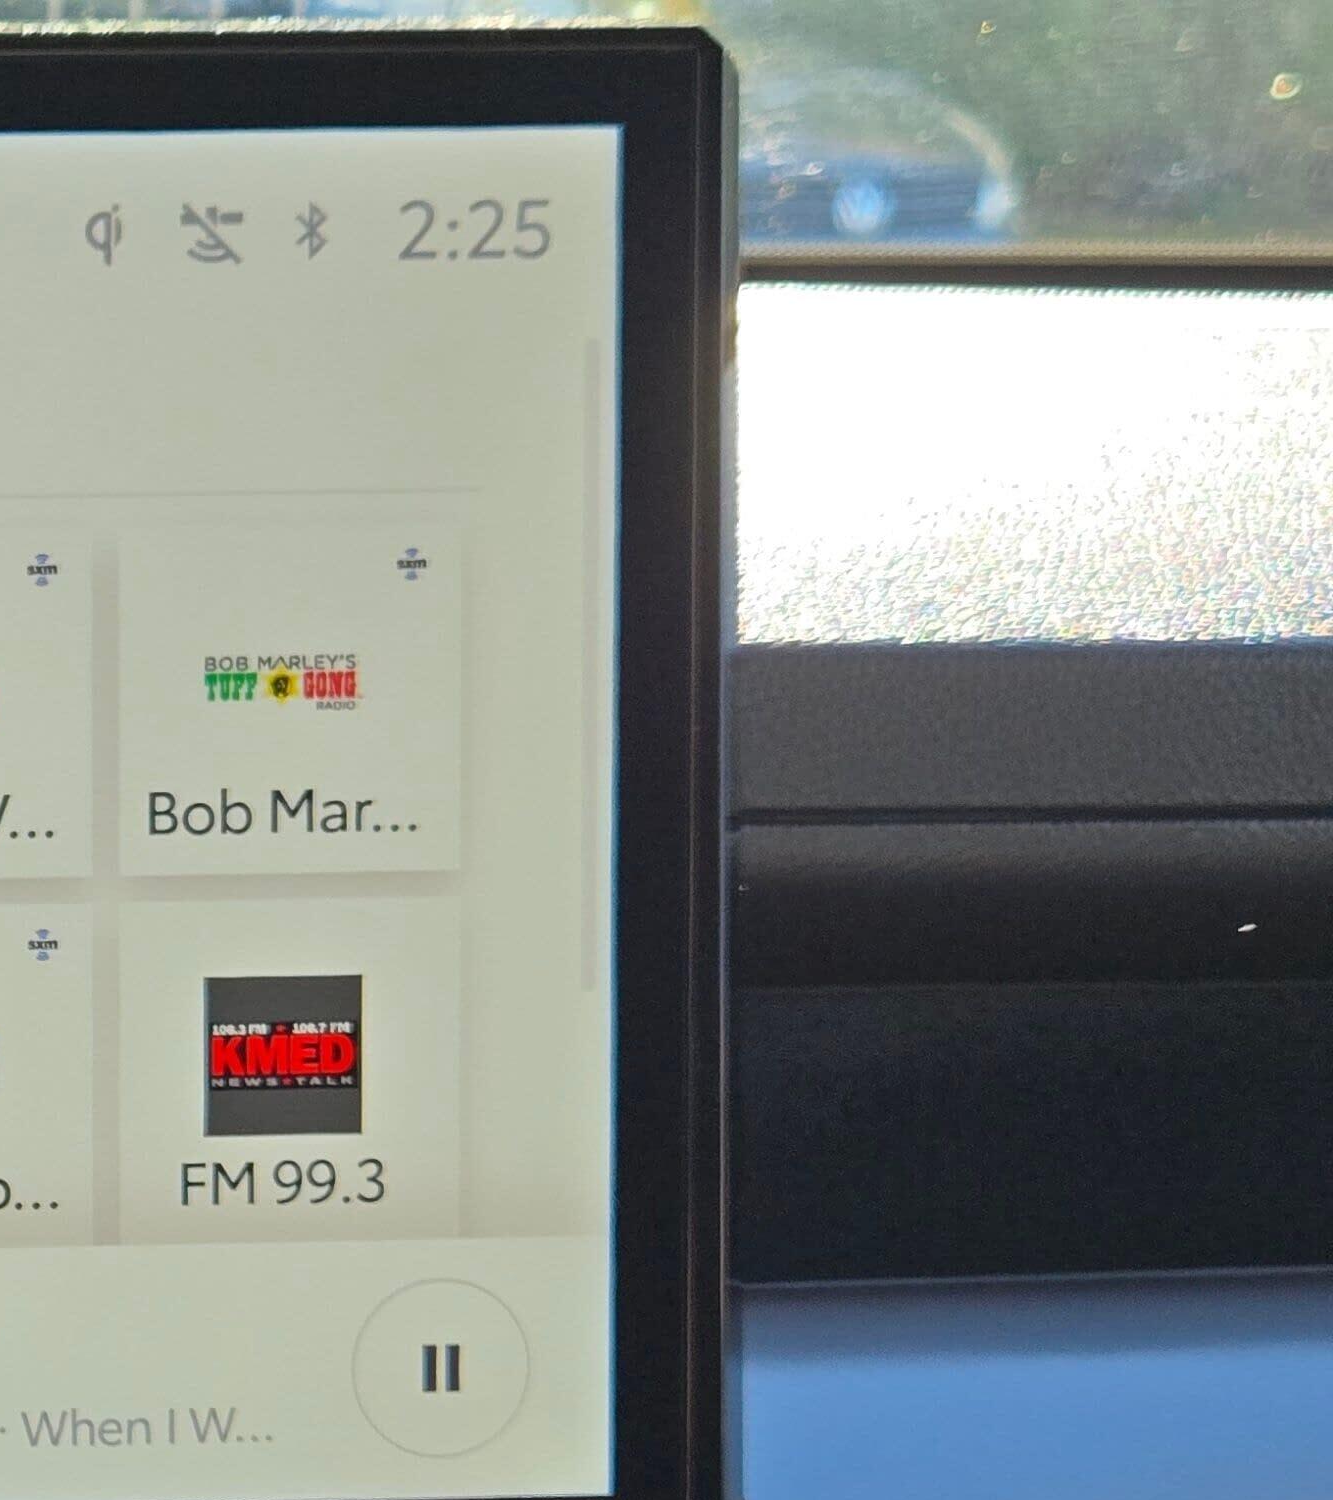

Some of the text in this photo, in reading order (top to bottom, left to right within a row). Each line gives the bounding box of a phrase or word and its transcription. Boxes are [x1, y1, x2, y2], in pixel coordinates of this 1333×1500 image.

[399, 199, 550, 260] 2:25
[204, 653, 357, 672] BOB MARLEY'S
[204, 670, 357, 702] TUFF GONG
[316, 700, 357, 711] RADIO
[149, 788, 416, 835] Bob Mar...
[211, 1033, 356, 1077] KMED
[211, 1075, 354, 1088] NEWS TALK
[182, 1159, 384, 1205] FM 99.3
[21, 1408, 151, 1447] When
[169, 1408, 175, 1444] I
